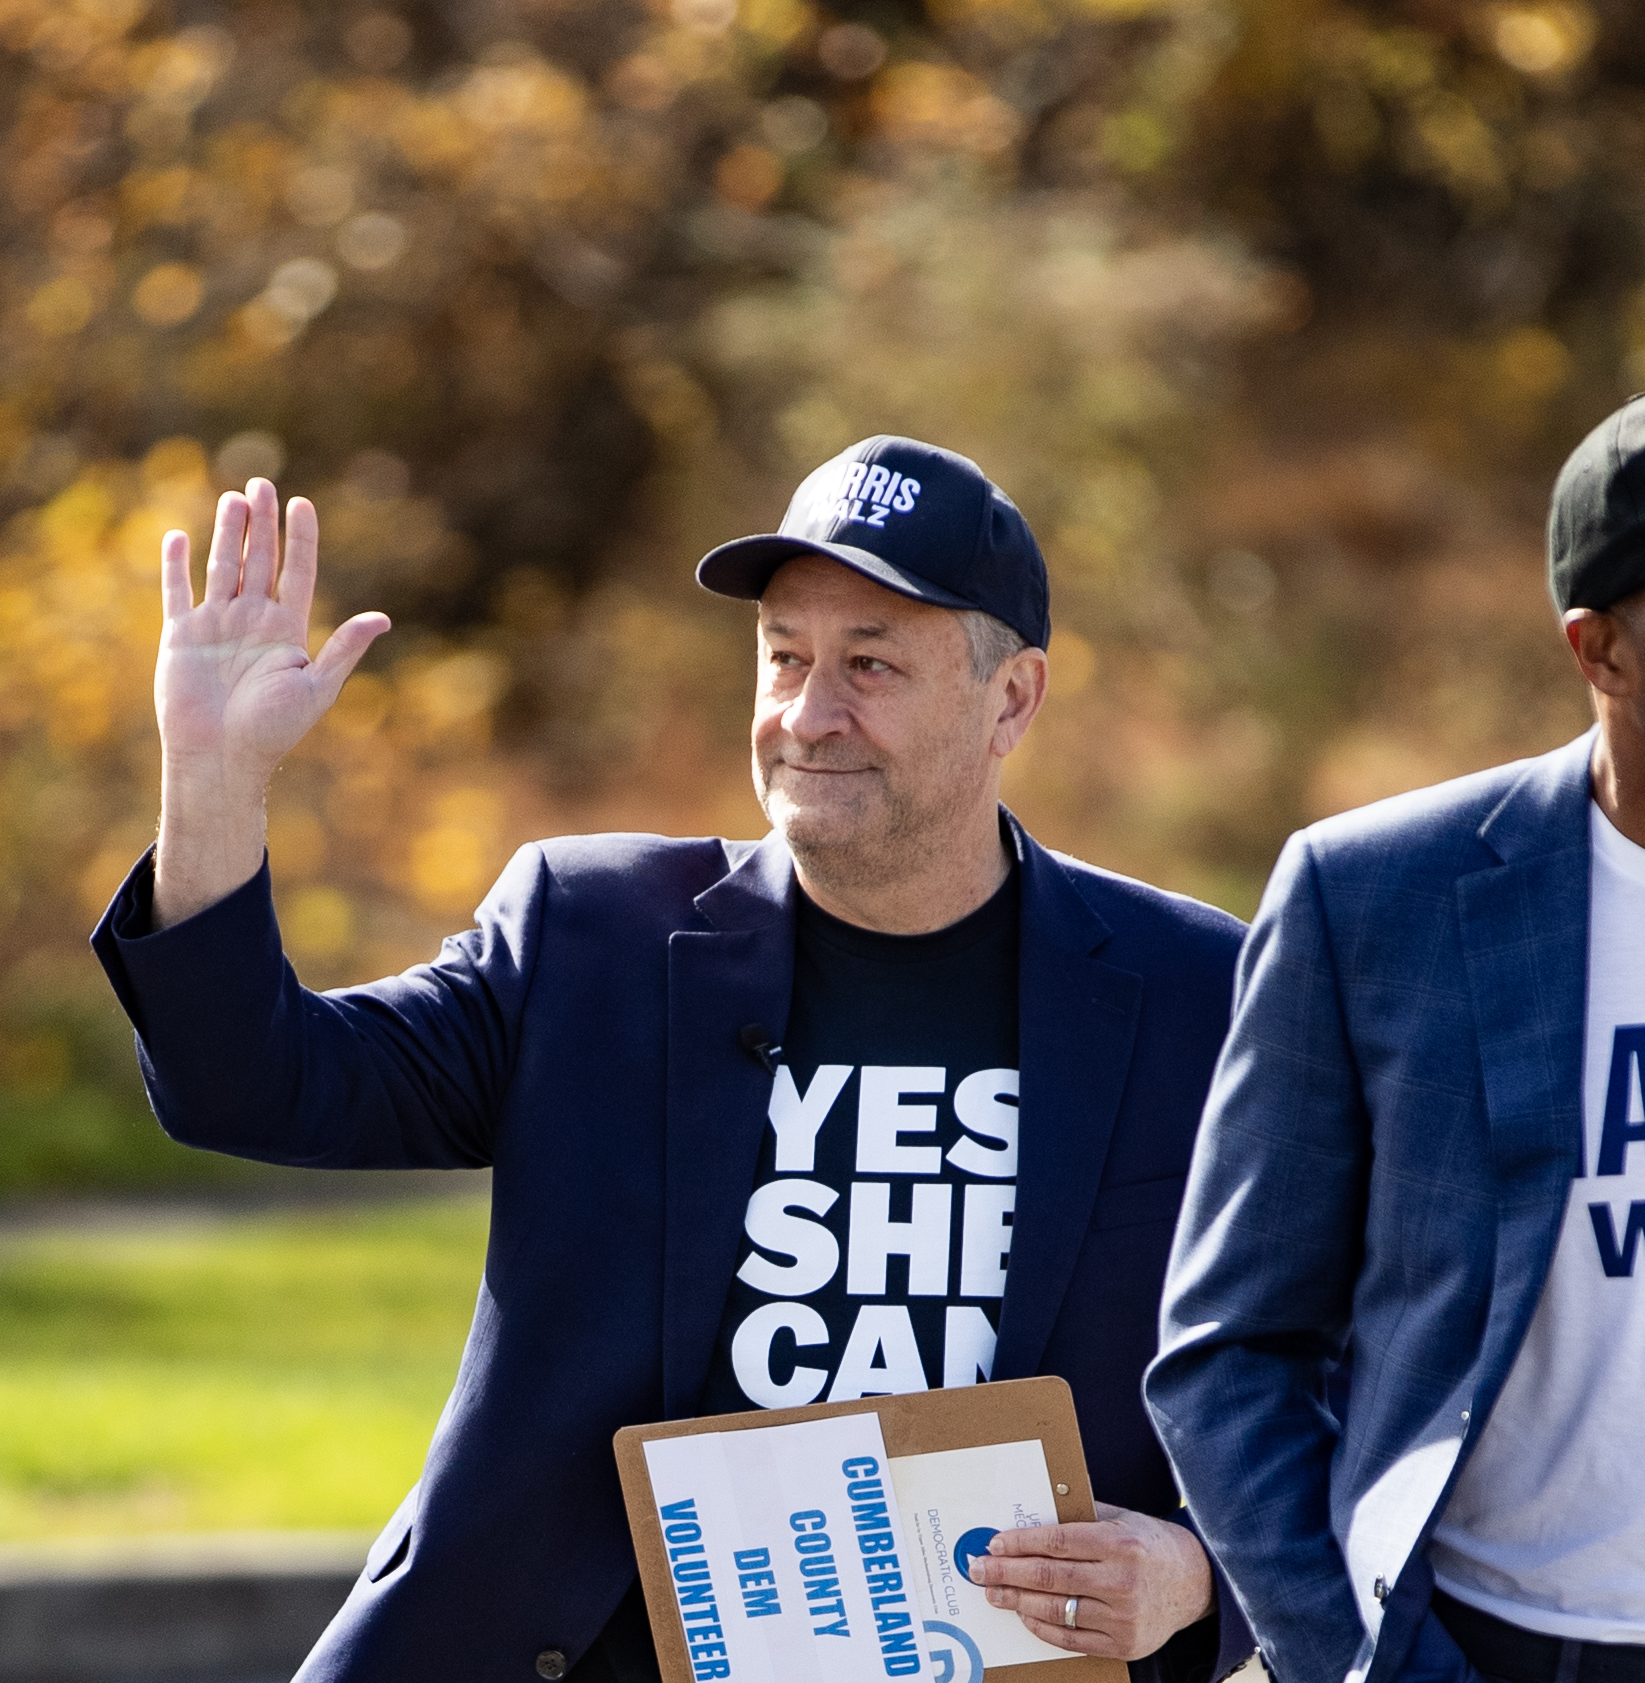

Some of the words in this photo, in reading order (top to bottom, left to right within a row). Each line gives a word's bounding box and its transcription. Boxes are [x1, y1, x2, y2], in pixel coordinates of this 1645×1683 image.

[767, 1064, 1020, 1177] YES
[736, 1178, 1017, 1297] SHE
[660, 1498, 731, 1682] VOLUNTEER
[733, 1547, 782, 1618] DEM
[789, 1509, 851, 1638] COUNTY
[841, 1455, 921, 1677] CUMBERLAND
[927, 1508, 953, 1583] DEMOCRATIC
[944, 1585, 960, 1616] CLUB
